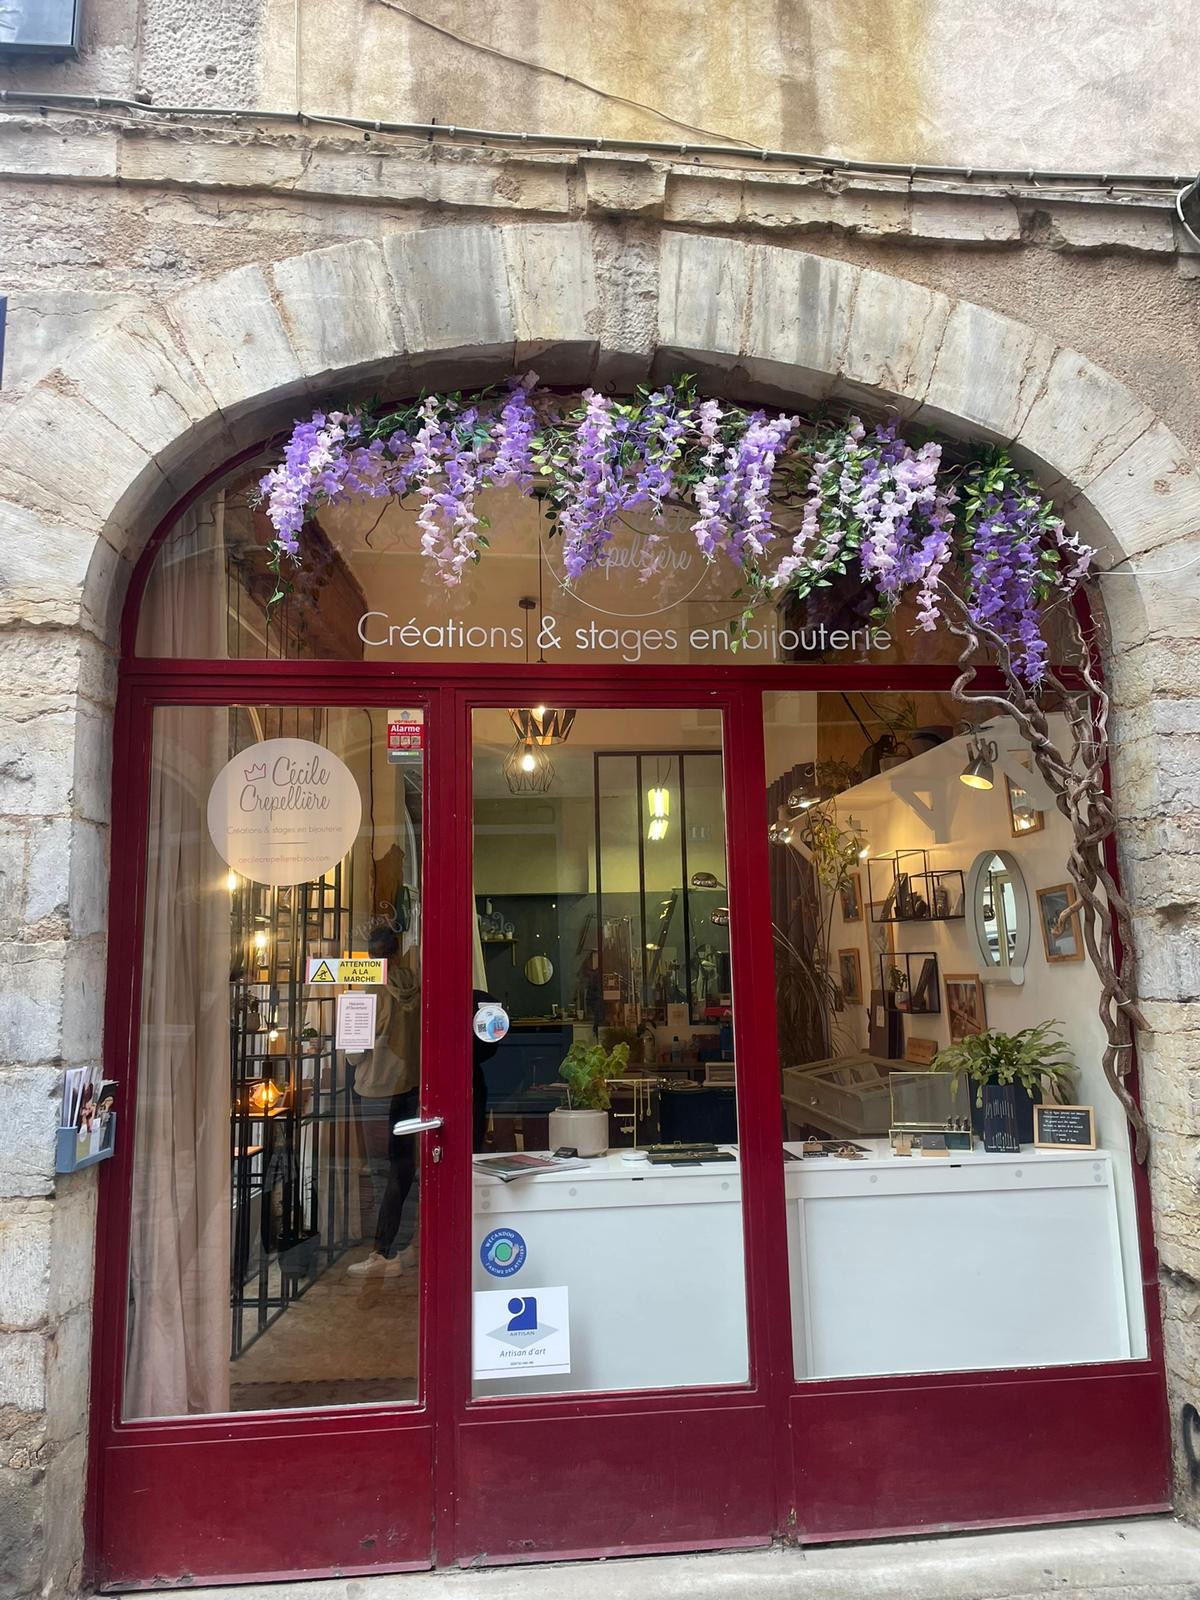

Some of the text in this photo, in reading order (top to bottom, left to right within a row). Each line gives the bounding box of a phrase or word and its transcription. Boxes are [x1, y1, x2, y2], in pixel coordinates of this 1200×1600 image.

[358, 611, 892, 662] Créations & stages en bijouterie
[390, 724, 421, 733] Alarme
[272, 755, 331, 787] Cécile
[239, 784, 331, 821] Crepellière
[340, 960, 381, 968] ATTENTION
[499, 1347, 546, 1358] Artisan d'art
